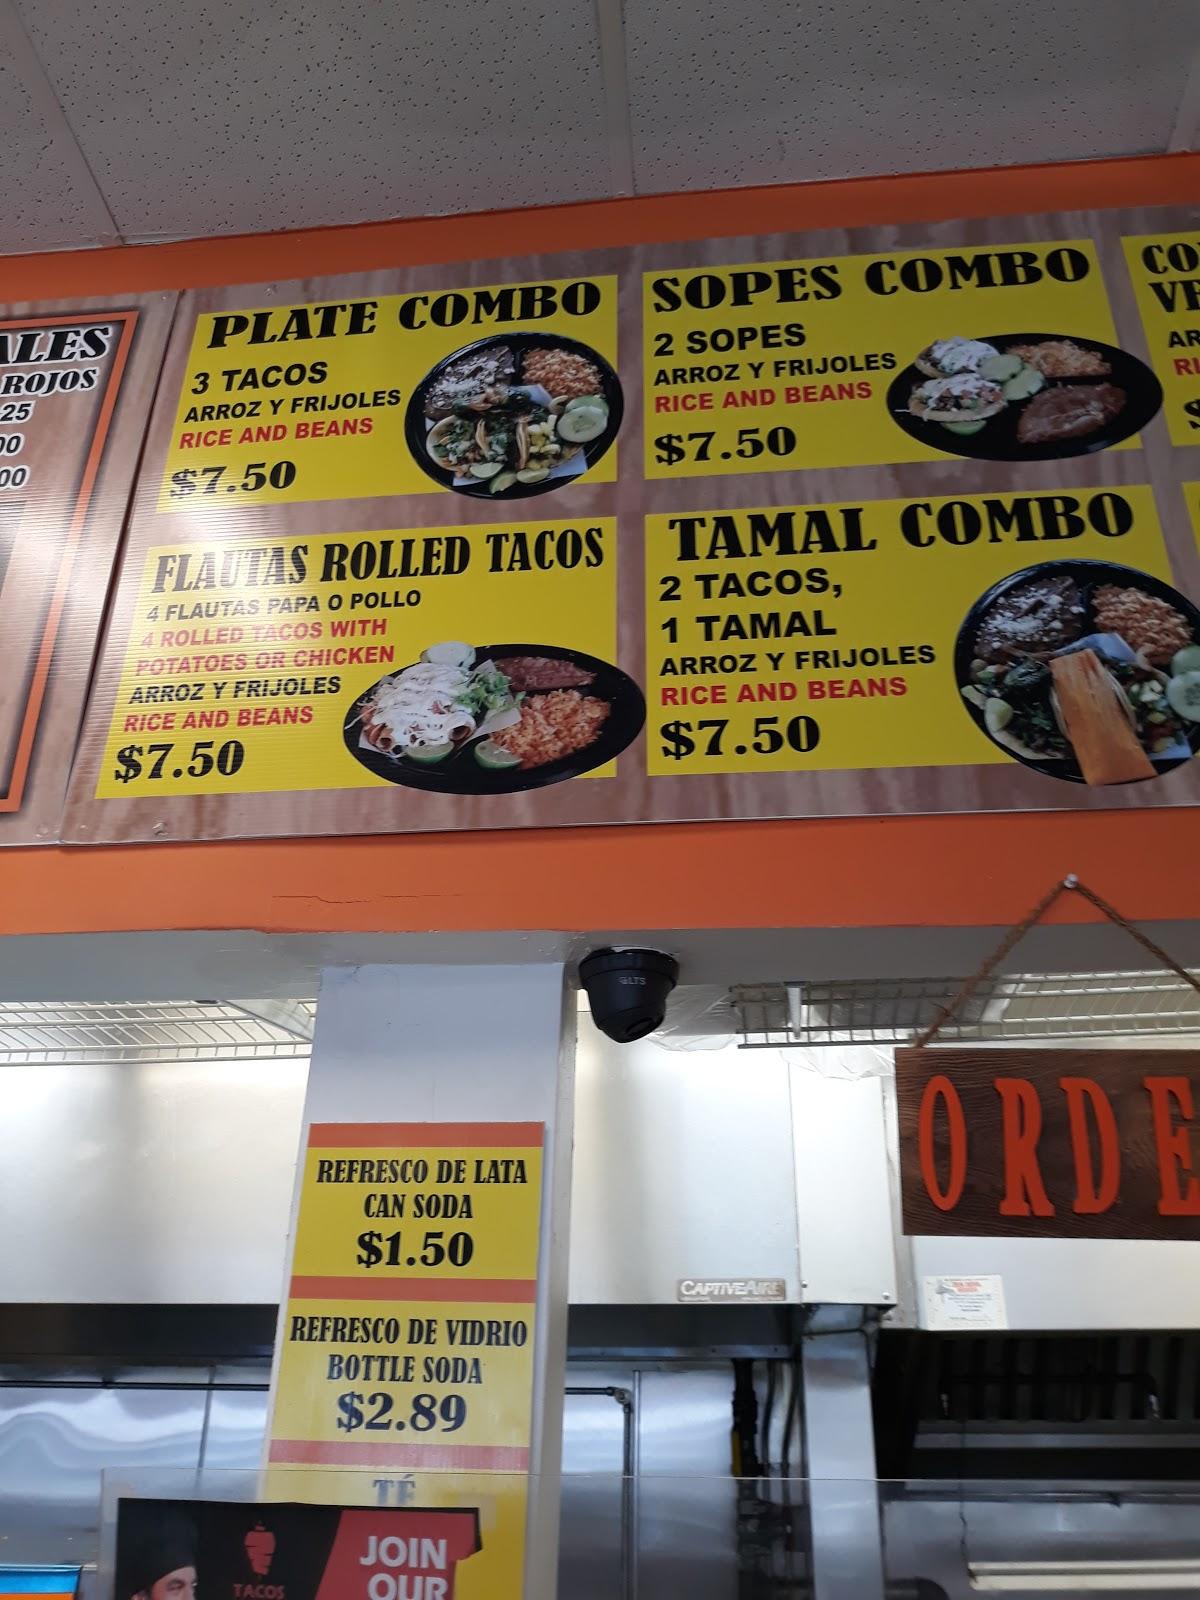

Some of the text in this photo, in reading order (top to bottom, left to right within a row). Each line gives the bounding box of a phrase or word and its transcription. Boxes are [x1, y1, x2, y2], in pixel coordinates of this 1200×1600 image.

[1141, 241, 1200, 275] CO
[652, 247, 1089, 313] SOPES COMBO
[207, 282, 601, 349] PLATE COMBO
[654, 322, 806, 357] 2 SOPES
[1, 369, 96, 395] ROJOS
[191, 361, 328, 395] 3 TACOS
[654, 352, 896, 386] ARROZ Y FRIJOLES
[184, 389, 401, 424] ARROZ Y FRIJOLES
[655, 382, 872, 413] RICE AND BEANS
[179, 417, 373, 450] RICE AND BEANS
[654, 426, 796, 465] $7.50
[169, 460, 297, 499] $7.50
[668, 492, 1133, 562] TAMAL COMBO
[151, 527, 604, 594] FLAUTAS ROLLED TACOS
[659, 567, 842, 601] 2 TACOS,
[146, 589, 421, 622] 4 FLAUTAS PAPA O POLLO
[141, 618, 387, 649] 4 ROLLED TACOS WITH
[661, 609, 837, 643] 1 TAMAL
[135, 645, 394, 677] POTATOES OR CHICKEN
[660, 644, 935, 677] ARROZ Y FRIJOLES
[128, 675, 341, 704] ARROZ Y FRIJOLES
[661, 676, 908, 706] RICE AND BEANS
[123, 704, 313, 733] RICE AND BEANS
[660, 715, 820, 760] $7.50
[115, 739, 244, 783] $7.50
[918, 1075, 1200, 1216] ORDE
[316, 1159, 527, 1184] REFRESCO DE LATA
[364, 1194, 473, 1218] CAN SODA
[356, 1230, 473, 1268] $1.50
[290, 1316, 527, 1347] REFRESCO DE VIDRIO
[326, 1354, 482, 1384] BOTTLE SODA
[337, 1391, 467, 1433] $2.89
[372, 1474, 416, 1506] TÉ
[359, 1535, 447, 1570] JOIN
[233, 1584, 285, 1599] TACOS
[368, 1573, 448, 1600] OUR
